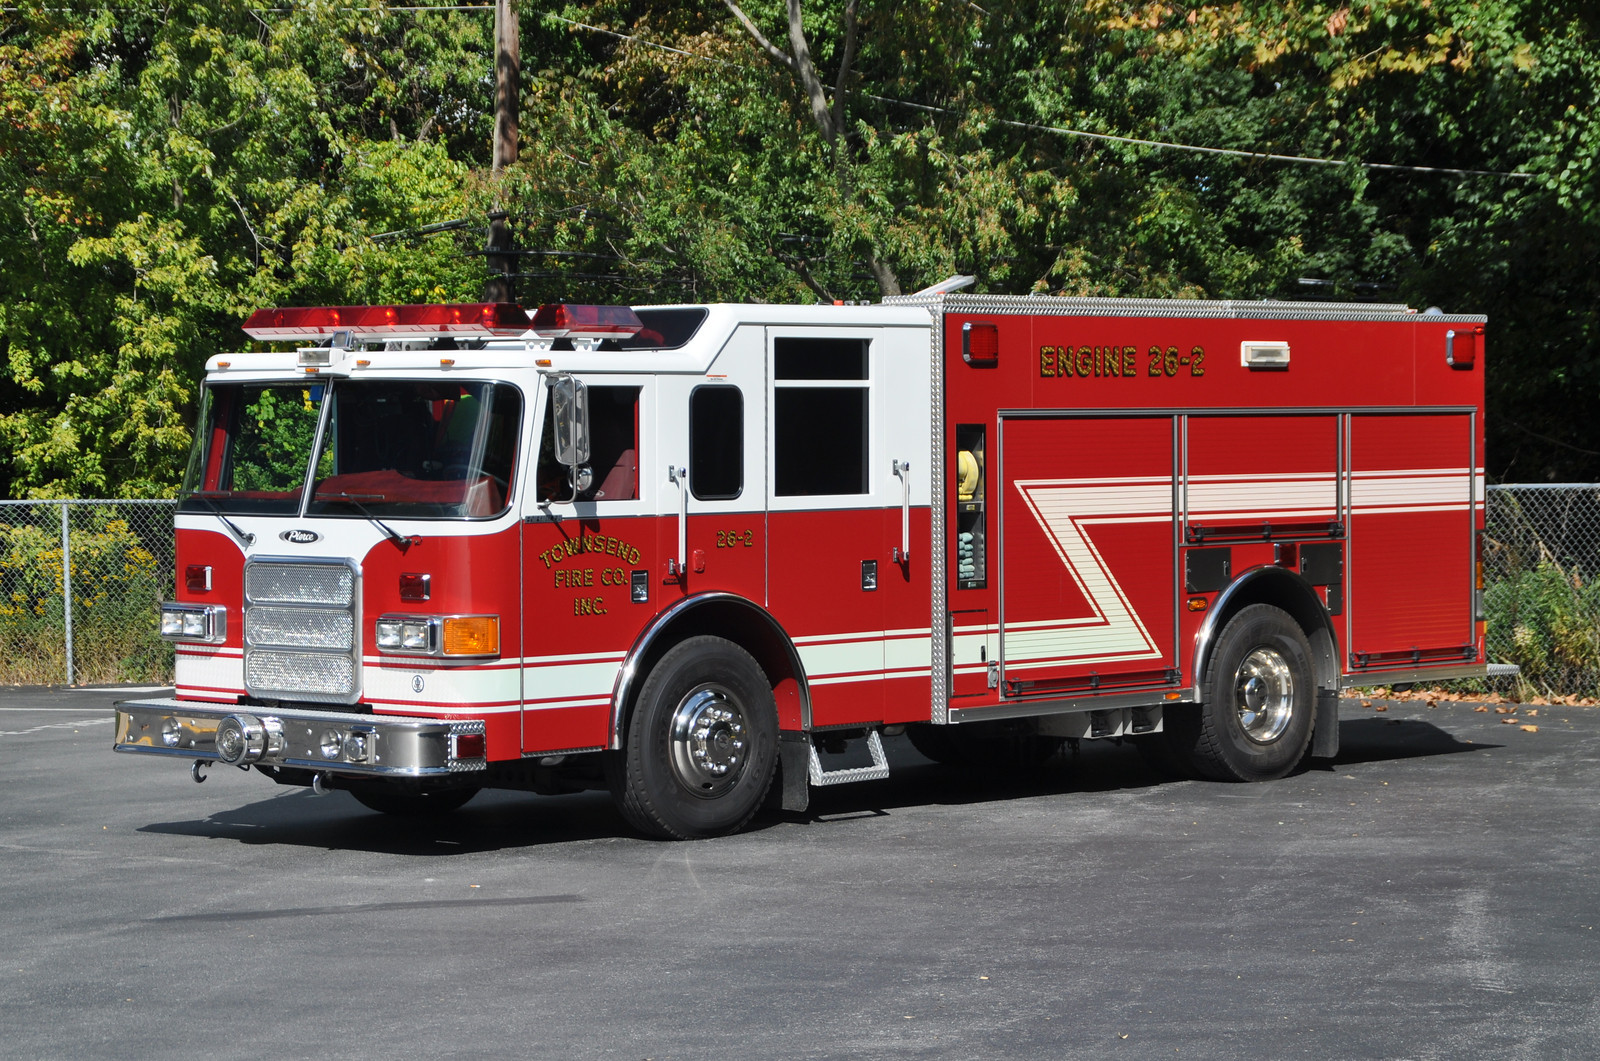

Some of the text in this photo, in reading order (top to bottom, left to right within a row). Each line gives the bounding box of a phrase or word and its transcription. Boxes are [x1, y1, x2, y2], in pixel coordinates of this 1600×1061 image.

[1040, 346, 1205, 377] ENGINE 26-2
[288, 531, 314, 541] Pierce
[717, 530, 753, 547] 26-2
[539, 534, 641, 568] TOWNSEND
[555, 567, 629, 587] FIRE CO.
[574, 597, 607, 615] INC.
